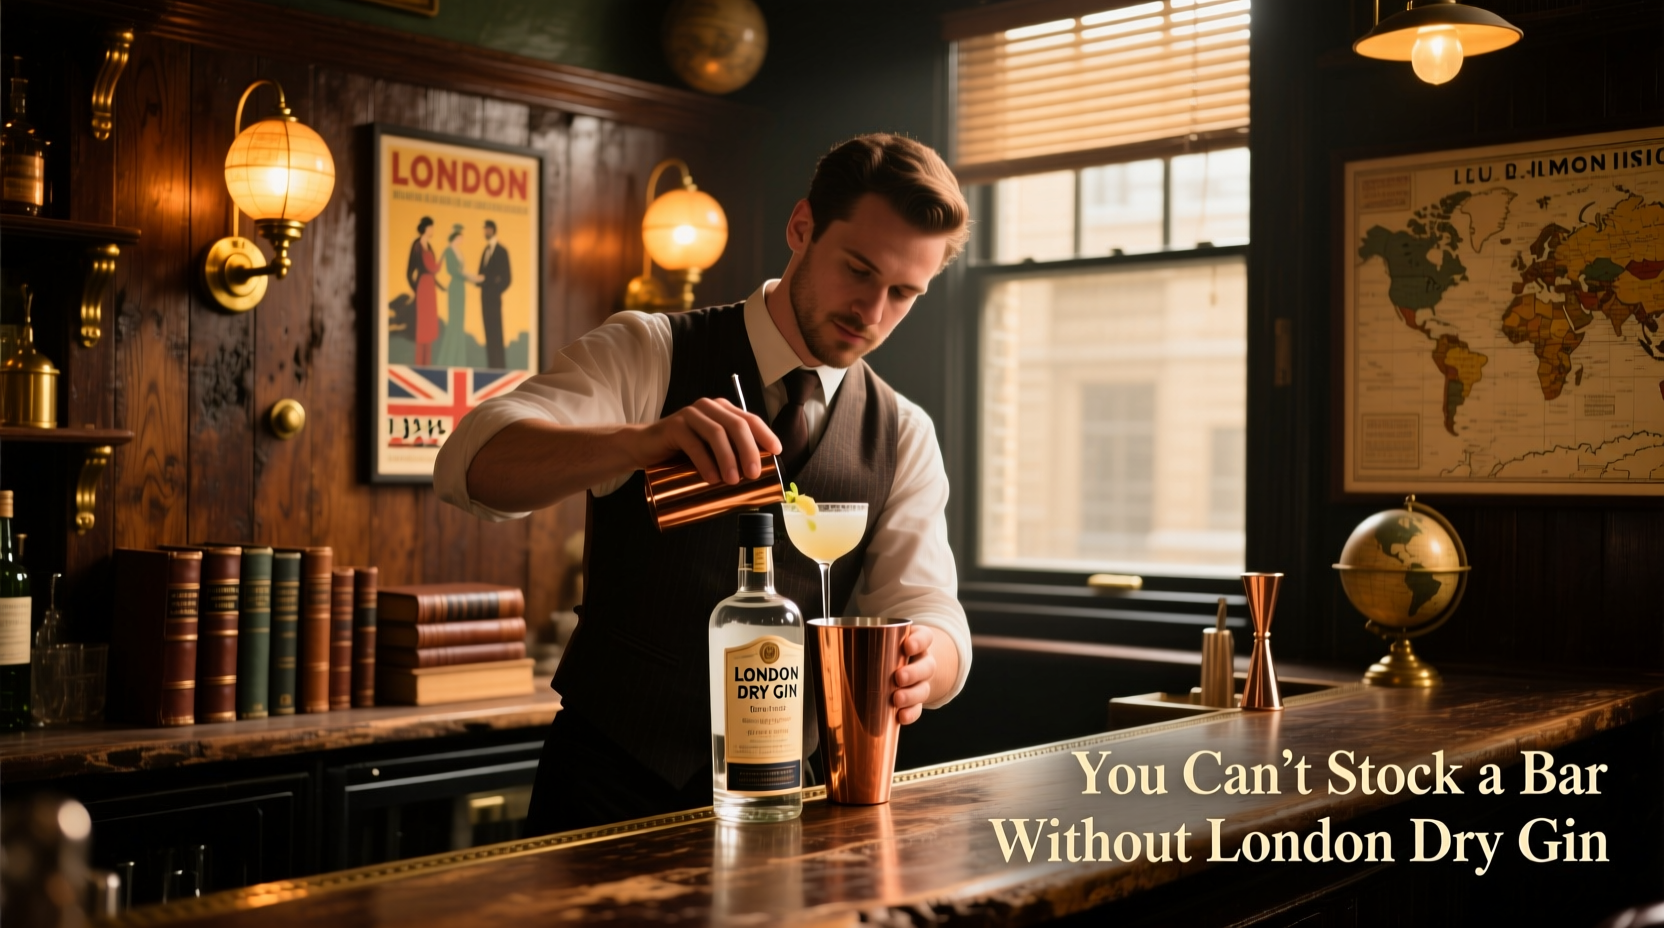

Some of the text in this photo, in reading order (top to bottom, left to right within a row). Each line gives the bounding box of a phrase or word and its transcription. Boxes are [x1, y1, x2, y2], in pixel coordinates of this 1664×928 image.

[391, 151, 528, 202] LONDON
[734, 666, 799, 682] LONDON
[737, 683, 798, 700] DRY GIN
